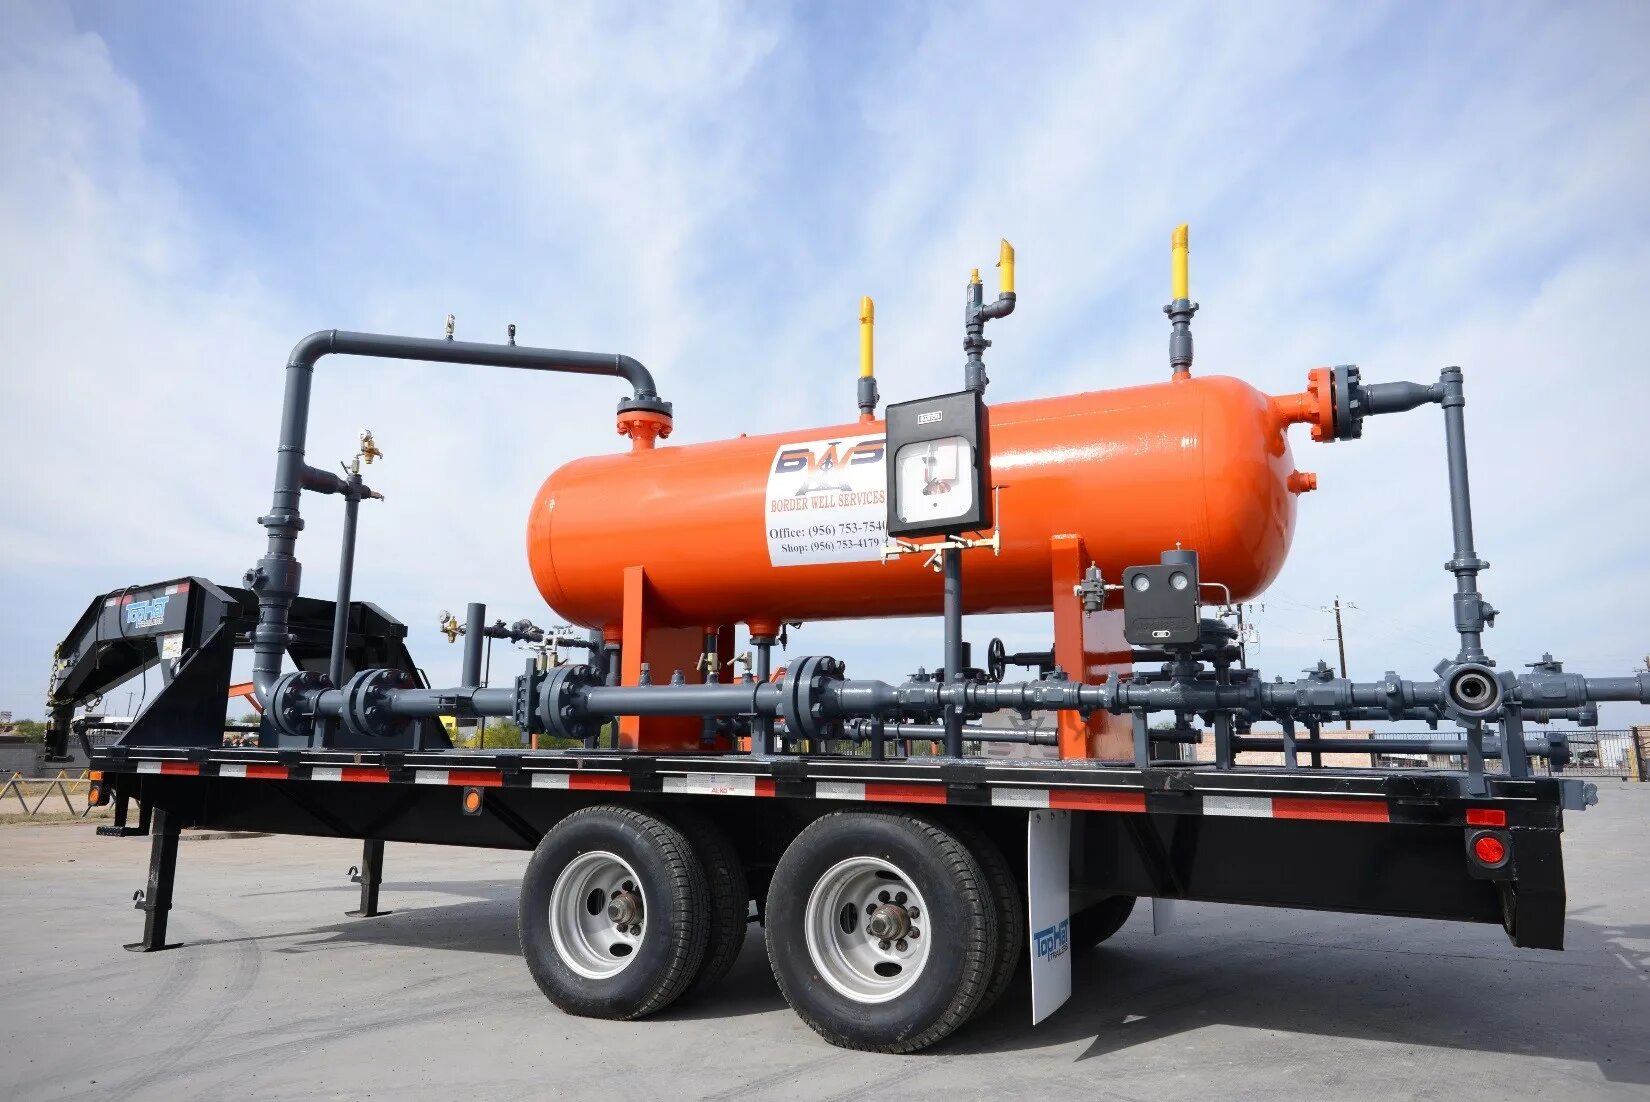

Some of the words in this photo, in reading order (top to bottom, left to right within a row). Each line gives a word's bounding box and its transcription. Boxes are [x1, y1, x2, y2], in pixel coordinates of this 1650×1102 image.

[771, 497, 808, 513] BORDER
[811, 494, 836, 509] WELL
[839, 490, 885, 507] SERVICES
[769, 527, 806, 539] Office:
[808, 524, 836, 538] (956)
[782, 543, 808, 554] Shop:
[810, 541, 835, 552] (956)
[837, 537, 879, 549] 753-4179
